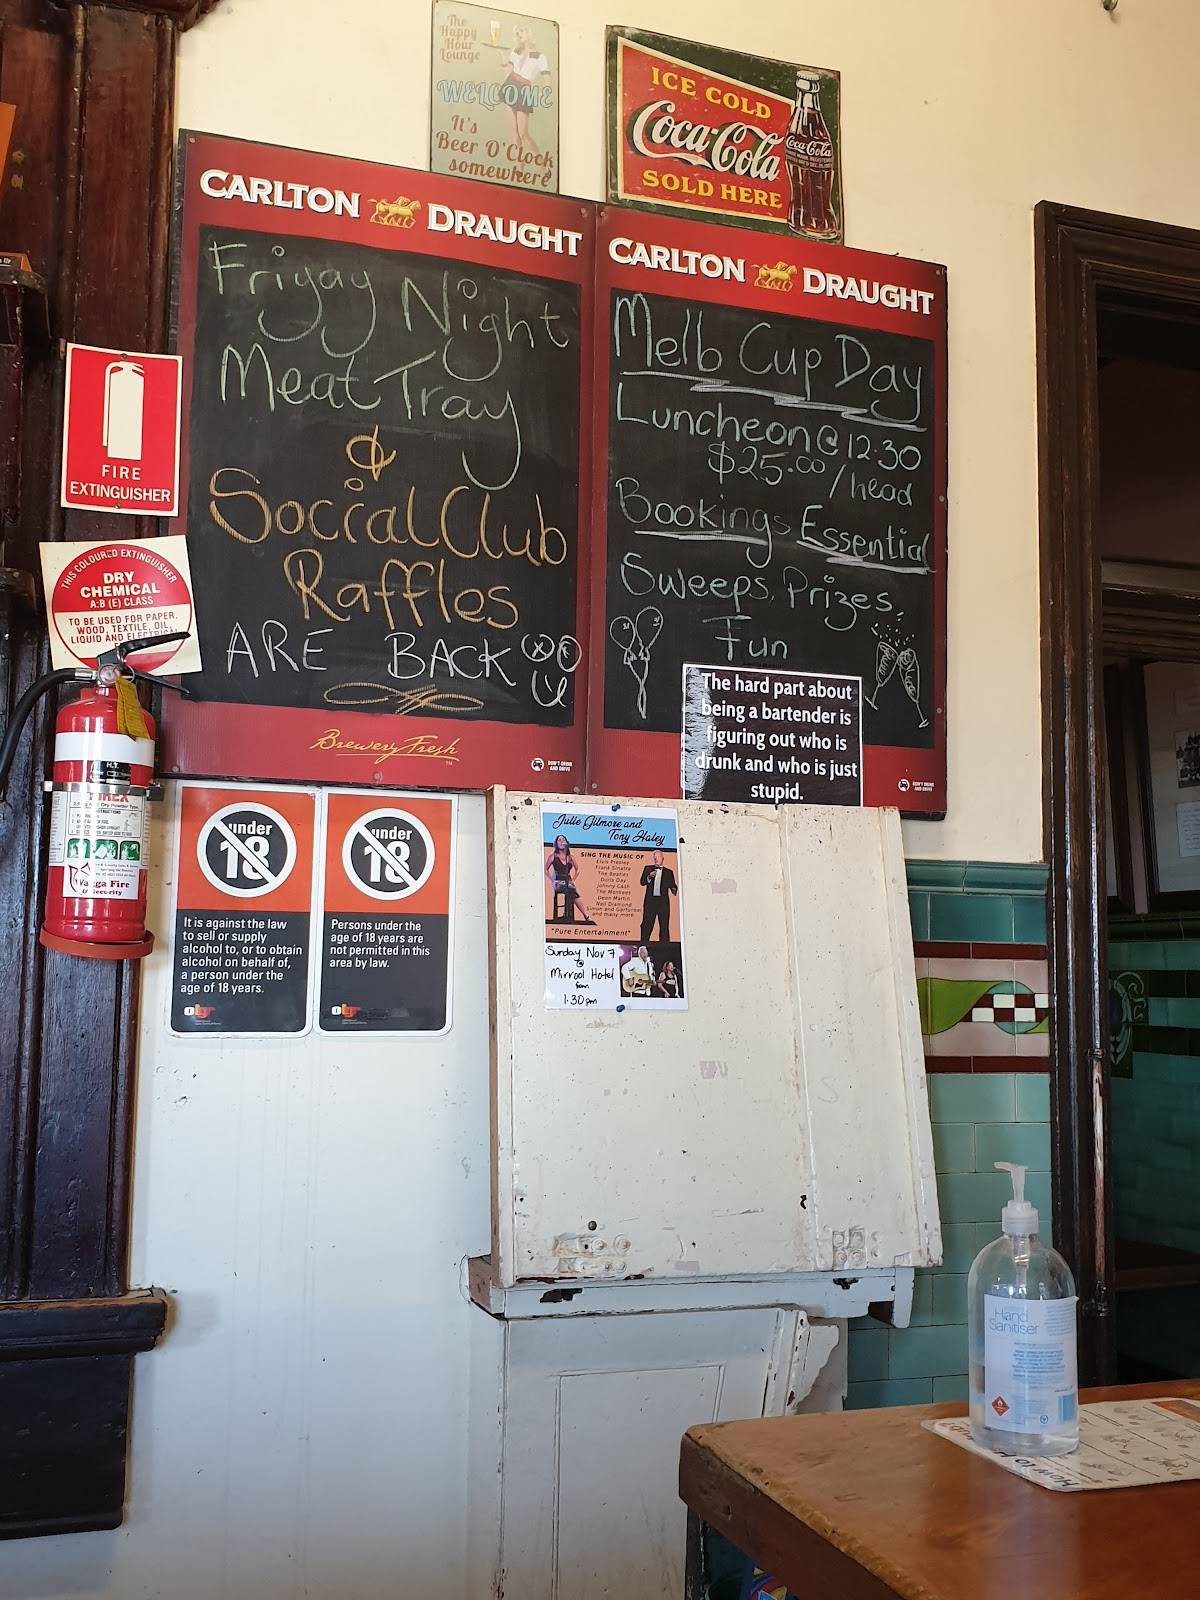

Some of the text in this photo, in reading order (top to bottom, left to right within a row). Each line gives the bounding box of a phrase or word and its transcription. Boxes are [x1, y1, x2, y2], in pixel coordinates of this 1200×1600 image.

[447, 14, 466, 26] The
[440, 25, 478, 40] Happy
[444, 38, 474, 50] Hour
[440, 49, 480, 63] Lounge
[437, 80, 553, 111] WELCOME
[651, 67, 772, 120] ICE COLD
[451, 114, 478, 134] It's
[436, 131, 554, 168] Beer O'Clock
[631, 100, 784, 182] Coca-Cola
[449, 158, 552, 187] somewhere
[641, 169, 783, 210] SOLD HERE
[199, 168, 582, 256] CARLTON DRAUGHT
[608, 237, 934, 315] CARLTON DRAUGHT
[402, 271, 569, 382] Night
[614, 292, 922, 424] Melb Cup Day
[220, 343, 522, 491] Meat Tray
[617, 382, 811, 453] Luncheon
[848, 433, 921, 471] 12.30
[101, 464, 141, 480] FIRE
[708, 440, 826, 486] $25.00
[70, 481, 171, 502] EXTINGUISHER
[209, 467, 567, 567] Social Club
[615, 477, 931, 569] Bookings Essential
[61, 548, 177, 589] THIS COLOURED EXTINGUISHER
[103, 571, 134, 584] DRY
[80, 583, 160, 598] CHEMICAL
[283, 548, 519, 630] Raffles
[783, 566, 893, 631] Prizes
[89, 596, 154, 609] A:B (E) CLASS
[68, 618, 80, 626] TO
[83, 617, 95, 625] BE
[97, 616, 121, 624] USED
[125, 614, 143, 623] FOR
[71, 635, 102, 644] LIQUID
[106, 634, 124, 642] AND
[702, 615, 788, 661] Fun
[226, 620, 516, 687] ARE BACK
[701, 672, 852, 700] The hard part about
[701, 698, 852, 726] being a bartender is
[310, 728, 461, 765] Brewery Fresh
[706, 725, 847, 751] figuring out who is
[695, 752, 858, 781] drunk and who is just
[751, 782, 804, 804] stupid.
[228, 820, 273, 836] under
[552, 814, 644, 830] Julie Gilmore and
[371, 826, 412, 841] under
[608, 828, 666, 846] Tony Haley
[220, 836, 270, 880] 18
[364, 841, 411, 884] 18
[110, 880, 130, 888] Fire
[184, 916, 287, 930] It is against the law
[331, 919, 422, 931] Persons under the
[183, 930, 267, 944] to sell or supply
[330, 932, 424, 945] age of 18 years are
[182, 943, 303, 955] alcohol to, or to obtain
[330, 945, 431, 957] not permitted in this
[545, 945, 615, 961] Sunday Nov 7
[182, 956, 291, 969] alcohol on behalf of,
[329, 957, 390, 970] area by law.
[181, 970, 284, 982] a person under the
[591, 968, 615, 980] Hotel
[181, 982, 264, 996] age of 18 years.
[994, 1307, 1029, 1323] Hand
[989, 1318, 1039, 1335] Sanitiser
